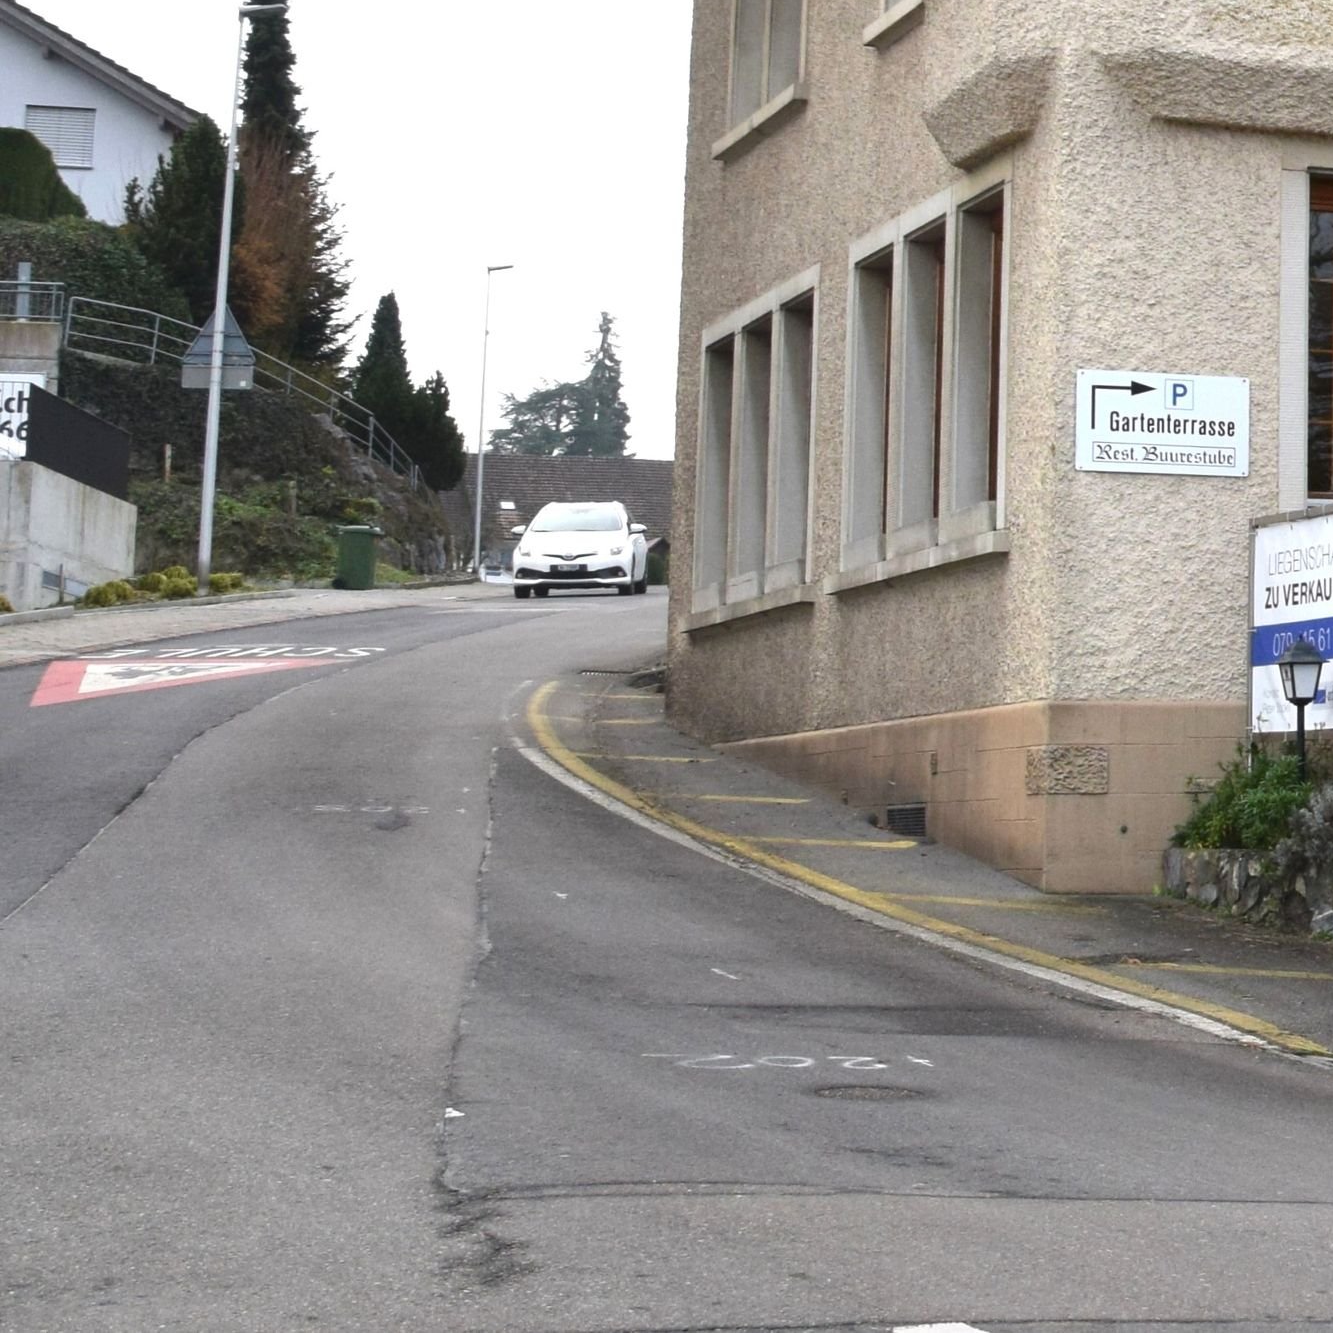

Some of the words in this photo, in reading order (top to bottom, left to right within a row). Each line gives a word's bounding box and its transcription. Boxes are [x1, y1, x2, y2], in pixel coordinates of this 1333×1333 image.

[1172, 383, 1188, 407] P
[1110, 411, 1236, 437] Gartenterrasse
[1096, 444, 1138, 462] Rest.
[1142, 446, 1234, 465] Buurestube
[1265, 586, 1280, 609] ZU
[1318, 627, 1330, 651] 61
[78, 647, 386, 659] SCHULE
